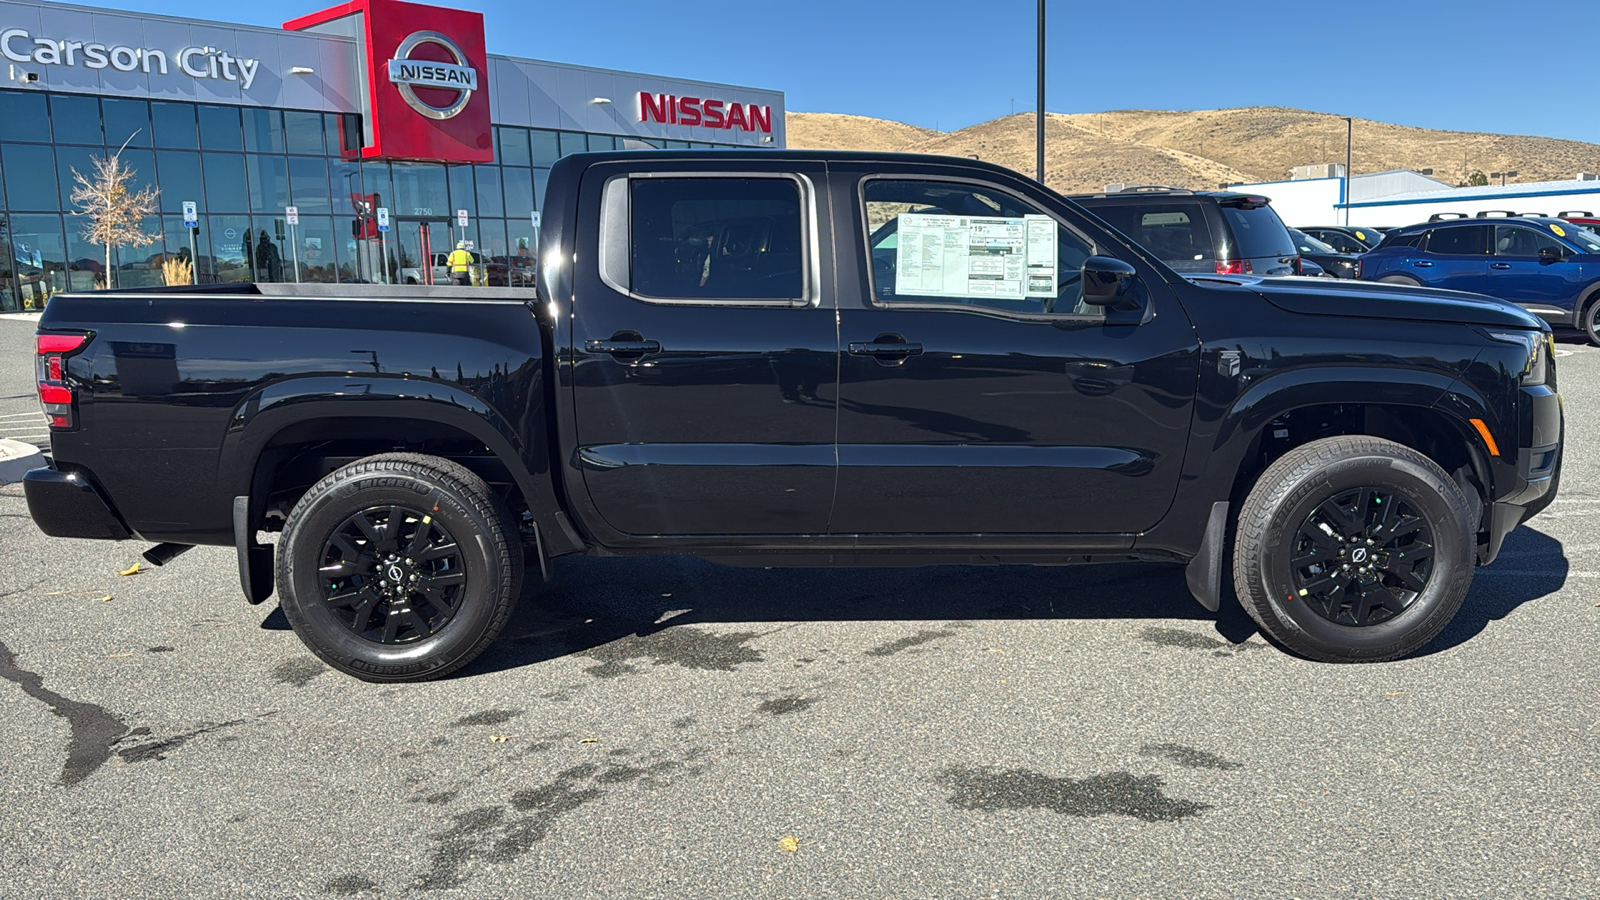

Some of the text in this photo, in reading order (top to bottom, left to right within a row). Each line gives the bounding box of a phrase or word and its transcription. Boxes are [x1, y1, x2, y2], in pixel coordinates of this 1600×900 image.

[0, 28, 260, 90] Carson City
[400, 64, 471, 85] NISSAN
[637, 91, 772, 133] NISSAN
[414, 207, 433, 216] 2750
[360, 477, 432, 496] MICHELIN
